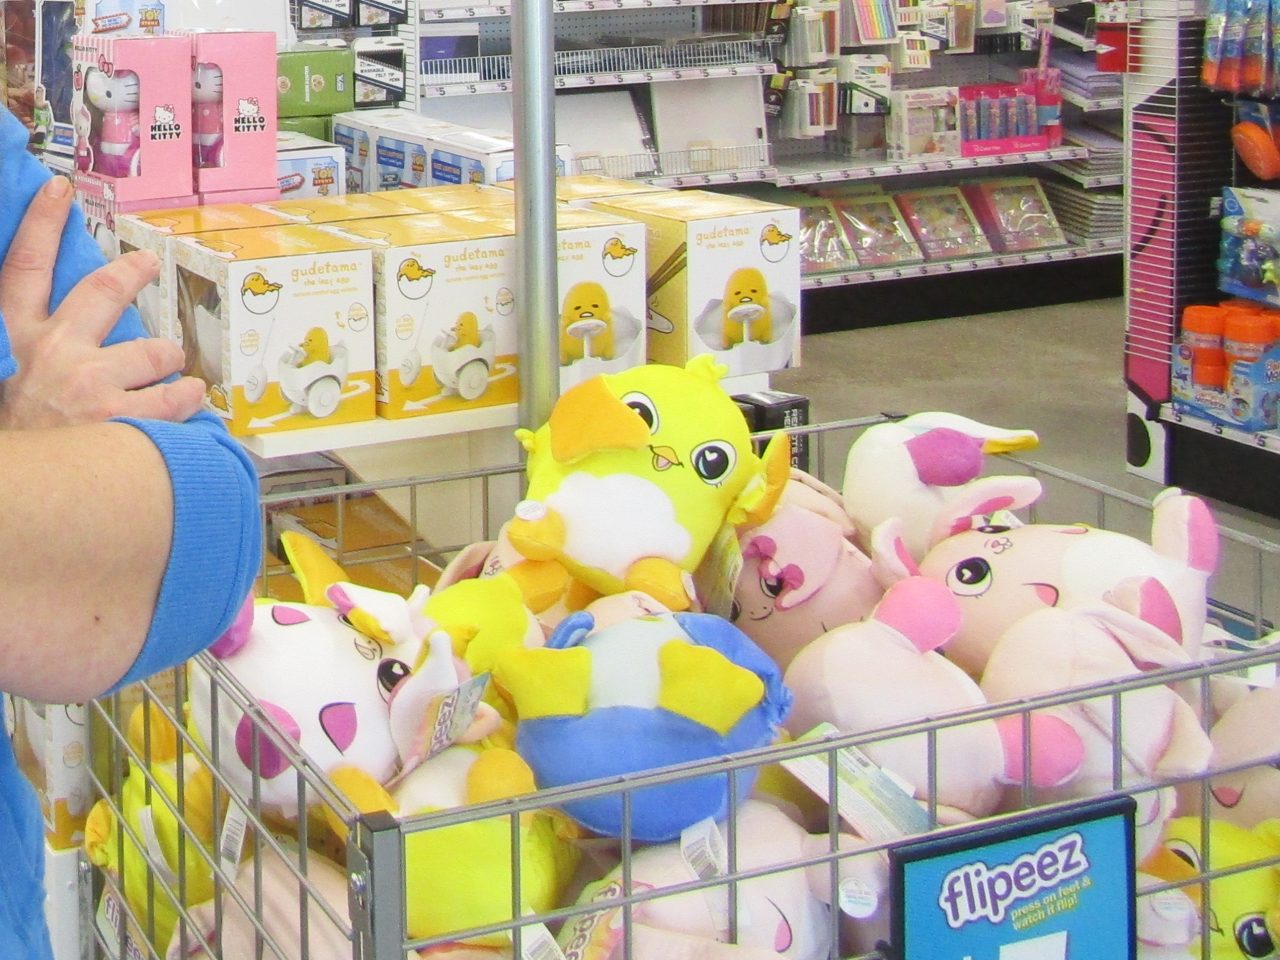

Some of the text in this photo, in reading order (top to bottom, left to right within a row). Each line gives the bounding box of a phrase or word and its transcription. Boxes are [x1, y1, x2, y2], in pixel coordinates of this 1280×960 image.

[150, 123, 181, 132] HELLO
[233, 116, 265, 125] HELLO
[234, 124, 266, 133] KITTY
[150, 132, 181, 141] KITTY
[312, 166, 336, 178] TOY
[696, 225, 750, 246] gudetama
[557, 238, 592, 250] etama
[443, 247, 505, 269] gudetama
[290, 261, 358, 283] gudetama
[943, 839, 1082, 921] flipeez
[1011, 900, 1041, 921] press
[1043, 893, 1056, 904] on
[1013, 911, 1045, 930] watch
[1047, 903, 1056, 915] it
